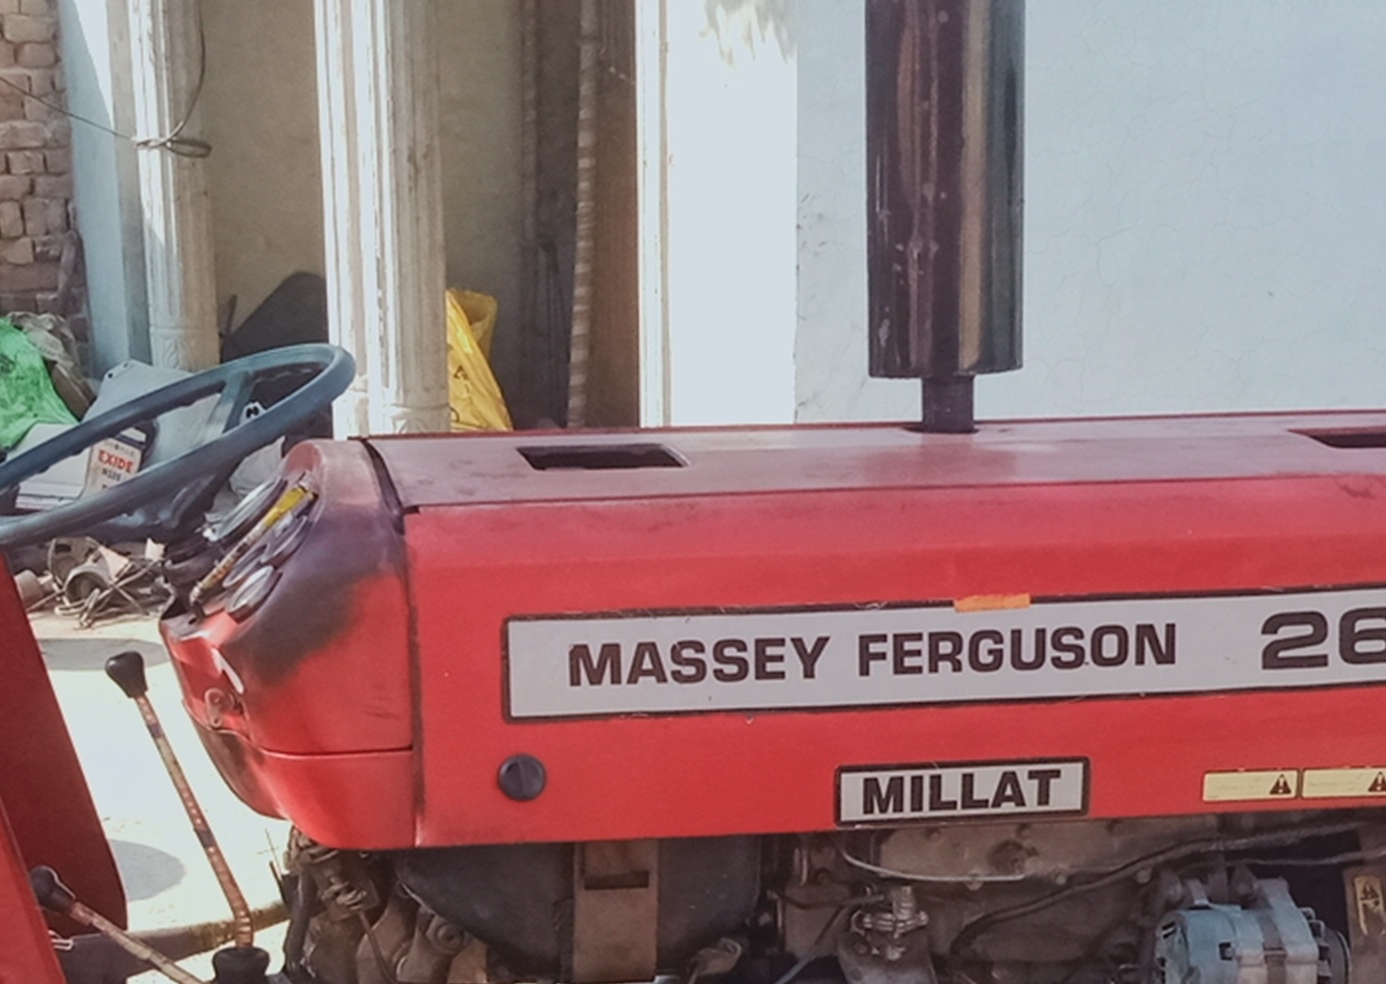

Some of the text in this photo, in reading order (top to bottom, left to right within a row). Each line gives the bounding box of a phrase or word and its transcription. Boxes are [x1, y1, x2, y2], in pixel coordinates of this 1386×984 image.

[98, 448, 134, 474] EXIDE
[567, 635, 831, 688] MASSEY
[857, 622, 1177, 678] FERGUSON
[862, 768, 1062, 816] MILLAT
